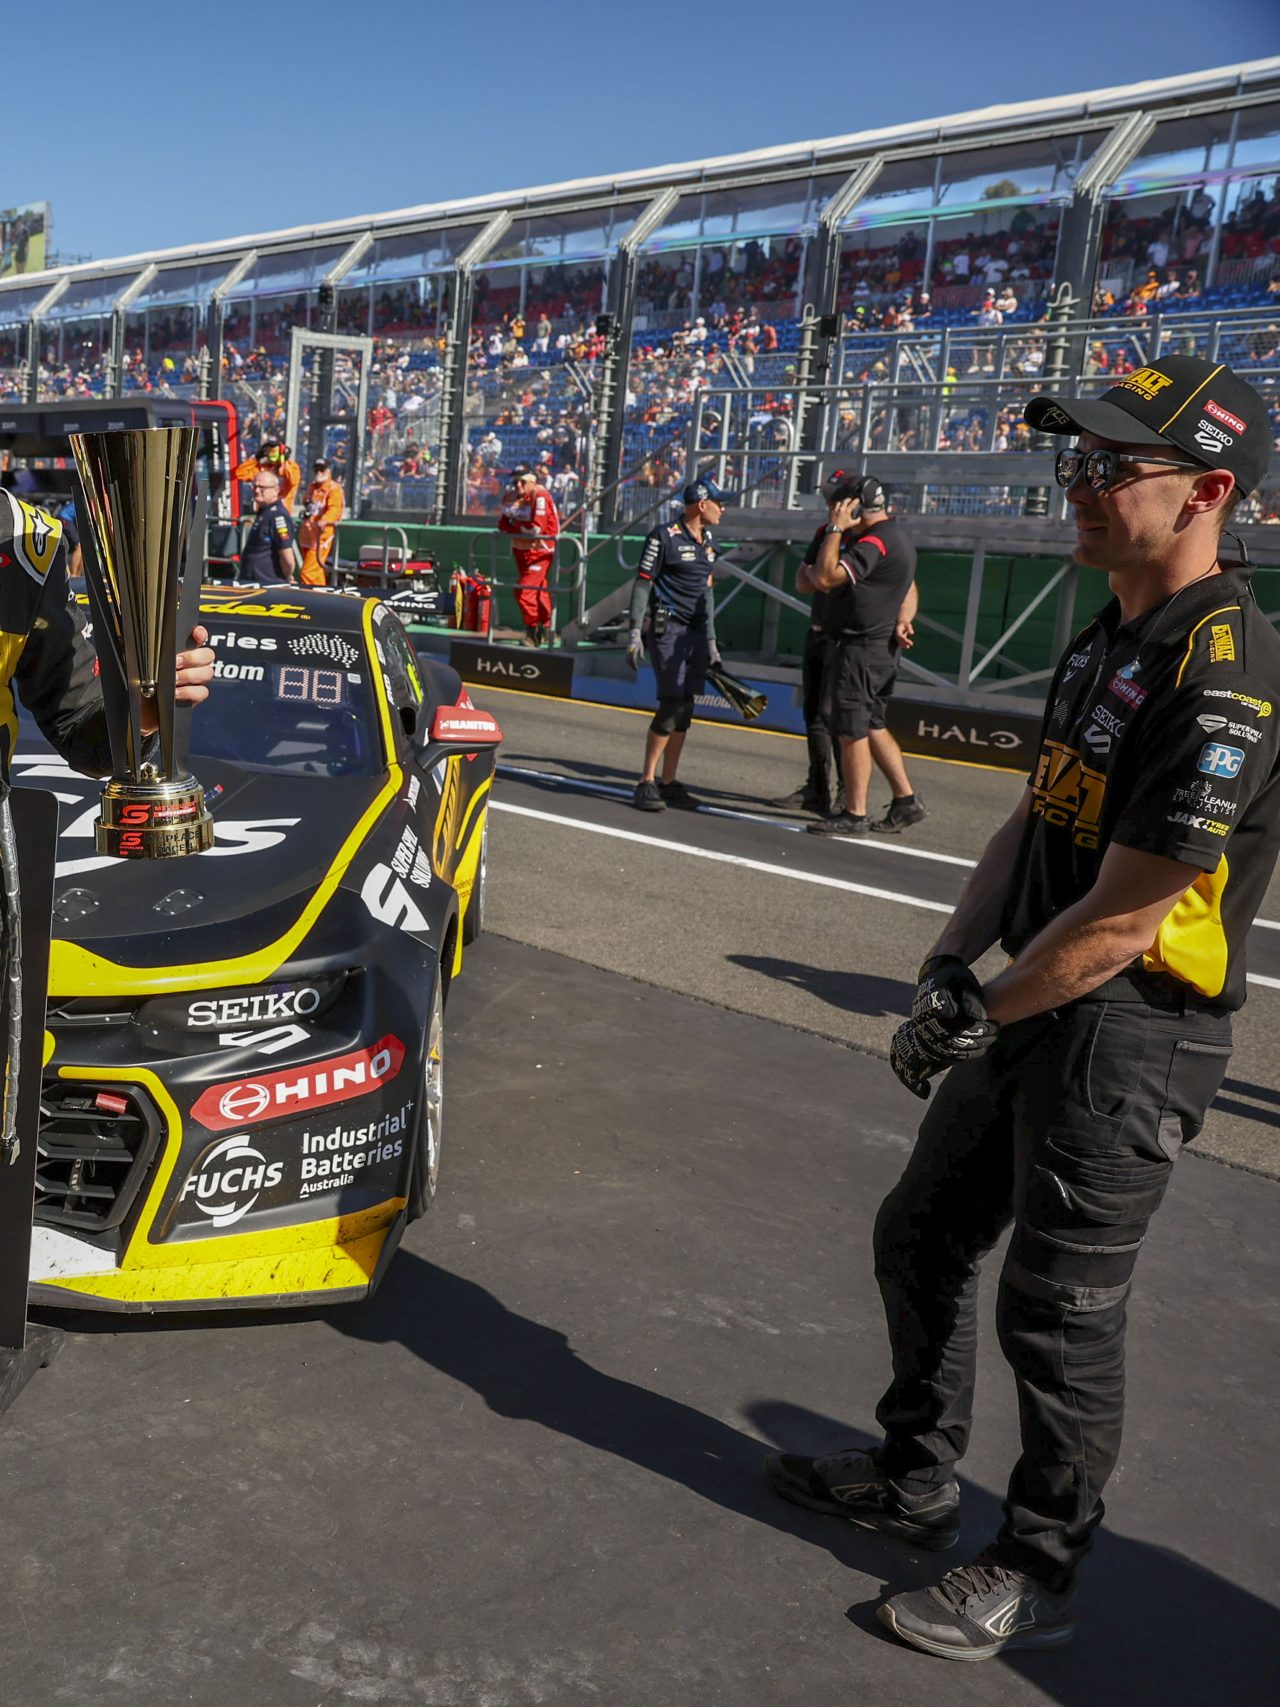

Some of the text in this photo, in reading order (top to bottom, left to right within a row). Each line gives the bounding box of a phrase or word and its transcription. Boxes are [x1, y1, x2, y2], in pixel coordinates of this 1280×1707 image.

[1114, 383, 1153, 400] ACING
[1215, 410, 1244, 431] HINO
[1198, 420, 1233, 446] SEIKO
[199, 601, 306, 619] det
[477, 658, 540, 678] HALO
[1120, 683, 1144, 705] HINO
[450, 720, 495, 731] MANITOU
[918, 720, 1022, 748] HALO
[1201, 747, 1242, 773] PPG
[1167, 811, 1206, 829] JAX
[1206, 819, 1230, 831] TYRES
[1207, 827, 1226, 837] AUTO
[187, 987, 320, 1027] SEIKO
[275, 1048, 391, 1104] HINO
[303, 1115, 407, 1155] Industrial
[301, 1138, 403, 1179] Batteries
[180, 1161, 283, 1202] FUCHS
[299, 1174, 355, 1198] Australia
